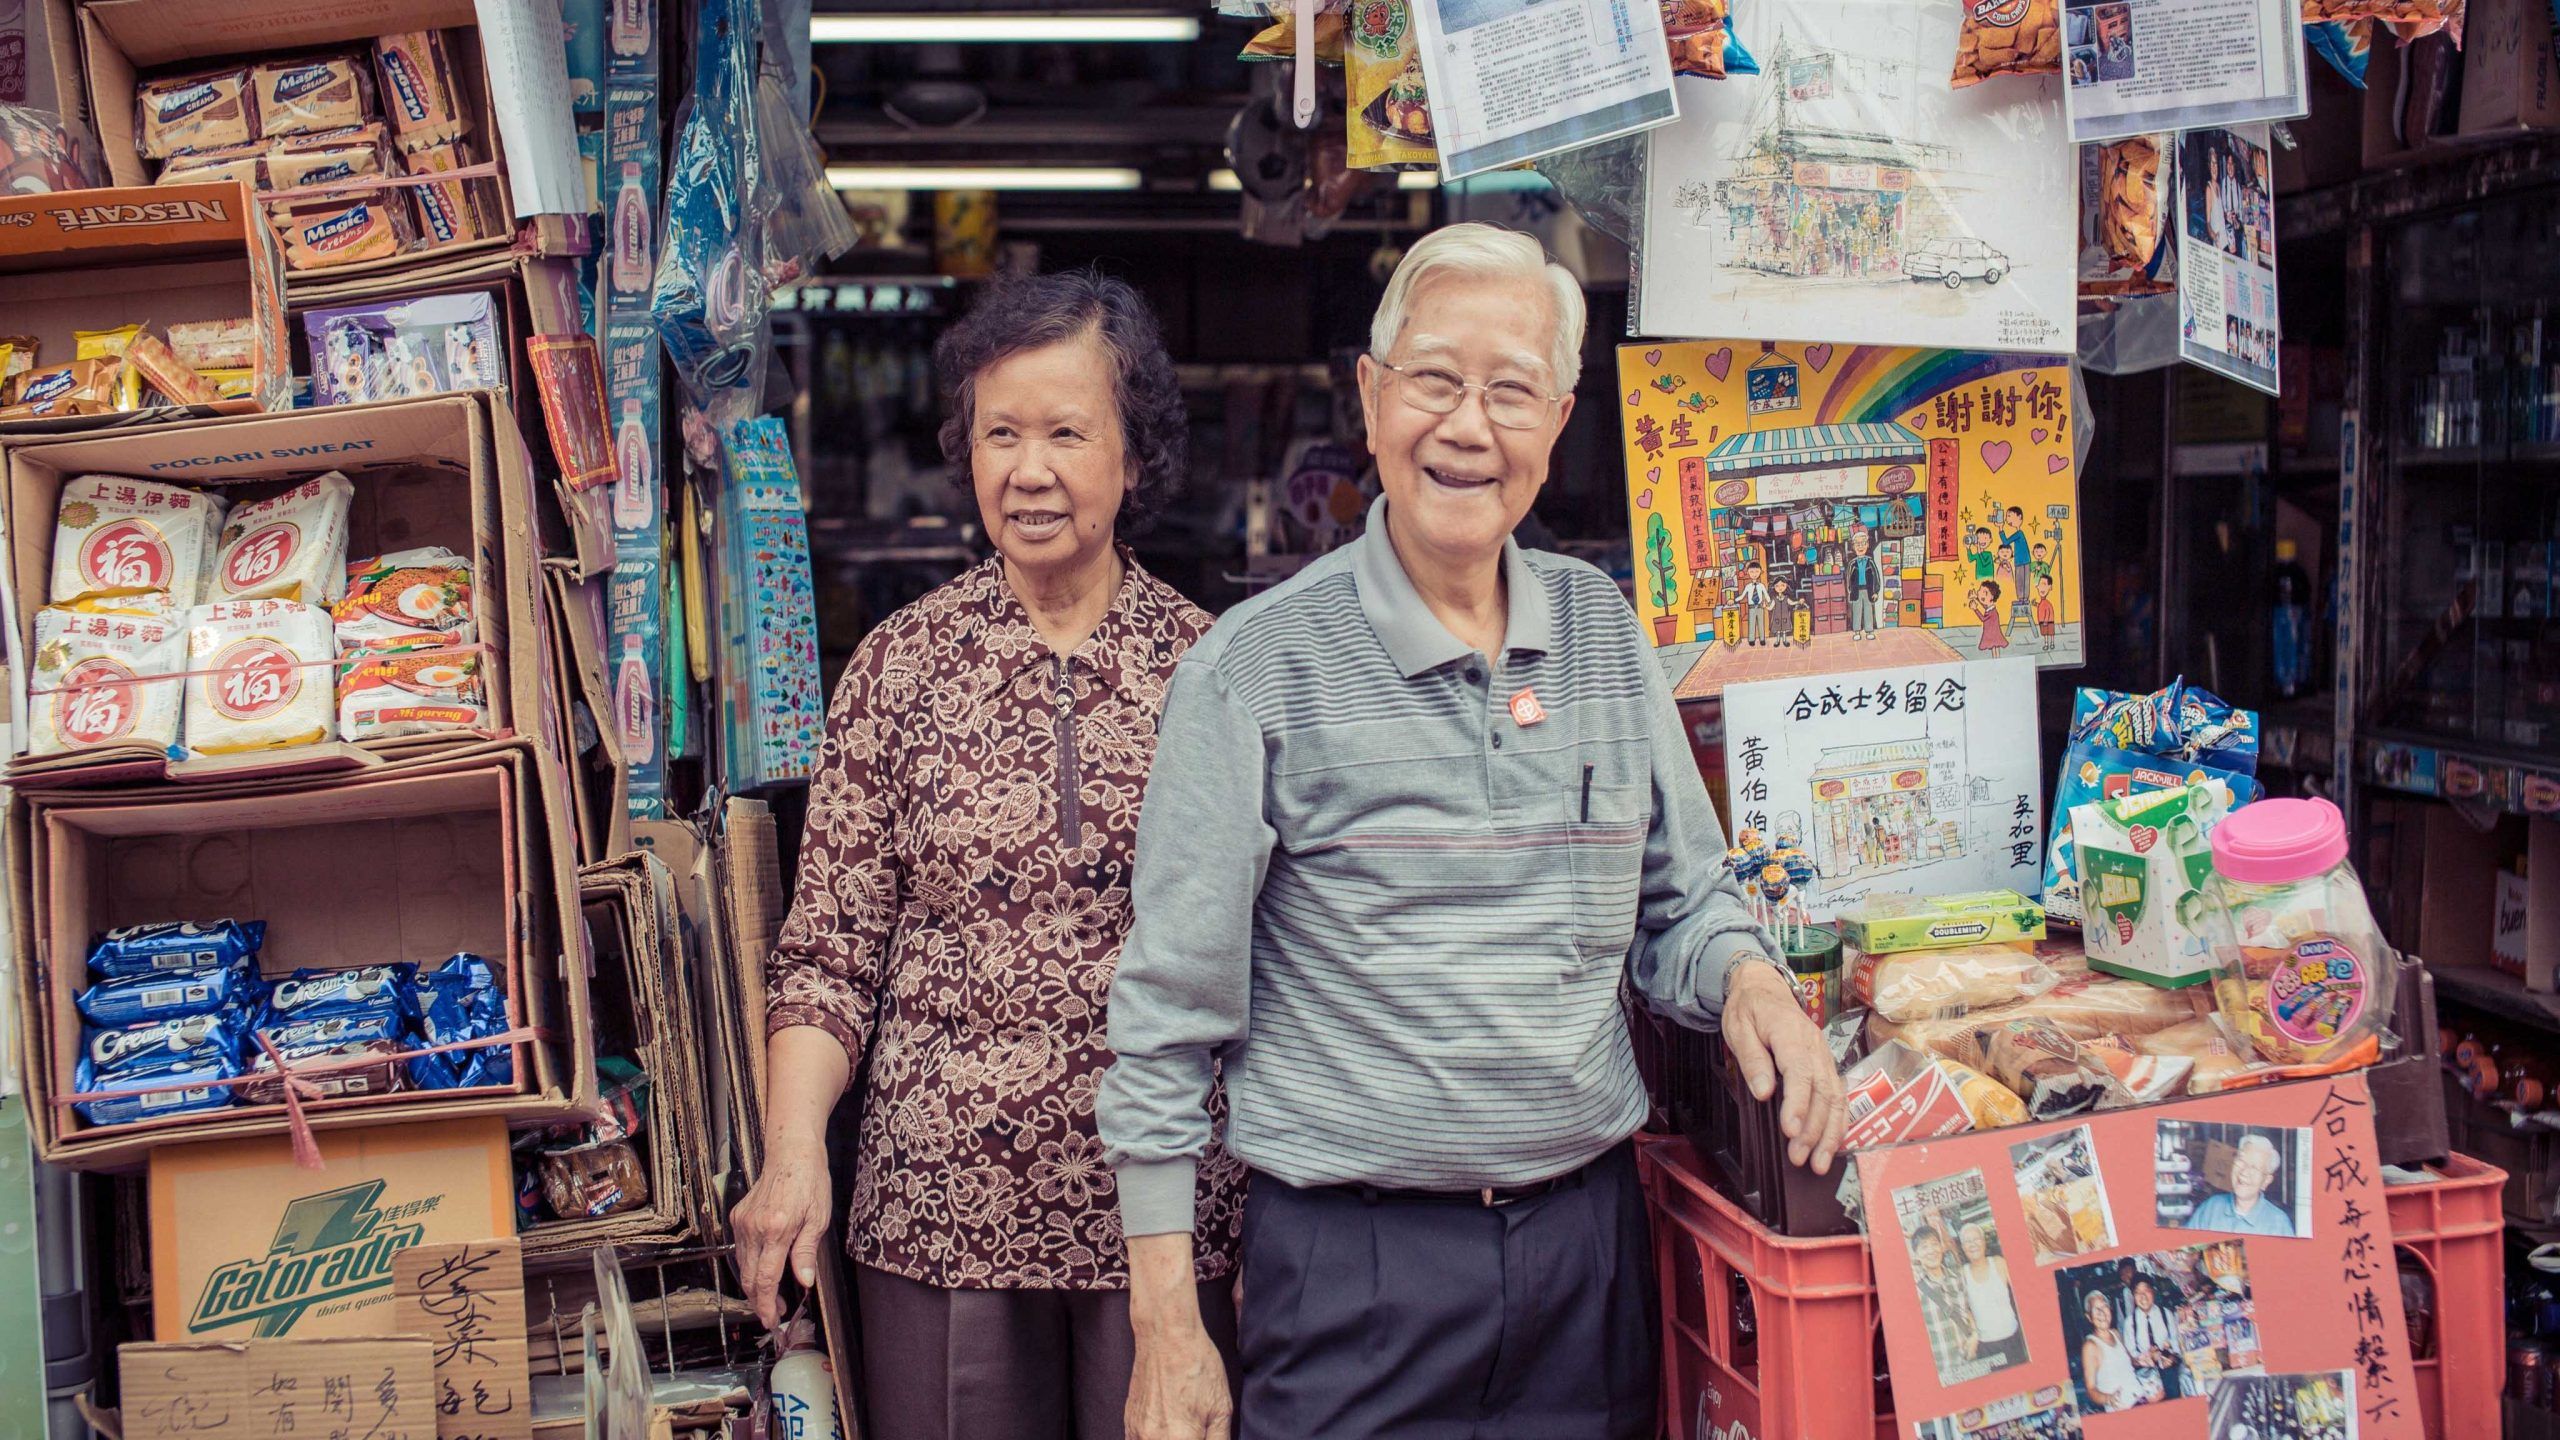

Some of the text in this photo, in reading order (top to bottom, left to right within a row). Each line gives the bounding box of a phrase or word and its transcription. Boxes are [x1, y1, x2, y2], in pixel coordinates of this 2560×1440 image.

[279, 66, 328, 91] Magic
[301, 77, 329, 92] CREAMS
[383, 50, 425, 122] Magic
[2536, 41, 2547, 110] FRAGILE
[164, 83, 213, 111] Magic
[186, 94, 215, 112] CREAMS
[1398, 151, 1435, 160] TAKOYAKI
[301, 162, 350, 185] Magic
[306, 212, 366, 244] Magic
[318, 226, 364, 254] Creams
[626, 204, 639, 267] Lucozade
[26, 372, 73, 400] Magic
[44, 384, 72, 400] CREAMS
[1750, 396, 1796, 411] 合成士多
[1934, 385, 2067, 444] 謝謝你!
[150, 439, 377, 471] POCARI SWEAT
[627, 442, 639, 503] Lucozade
[97, 534, 152, 588] 福
[234, 531, 285, 582] 福
[402, 633, 447, 645] goreng
[225, 652, 281, 707] 福
[67, 673, 121, 734] 福
[627, 678, 640, 738] Lucozade
[1786, 678, 1967, 722] 合成士多留念
[399, 708, 462, 721] Mi goreng
[1739, 736, 1769, 834] 黃伯伯
[2008, 794, 2037, 869] 吳加里
[2100, 811, 2121, 832] MELON
[1934, 925, 1984, 938] DOUBLEMINT
[1897, 1170, 1985, 1218] 士多的故事
[383, 1195, 441, 1222] 佳得樂
[316, 1301, 353, 1318] thirst
[1706, 1381, 1723, 1409] Enjoy
